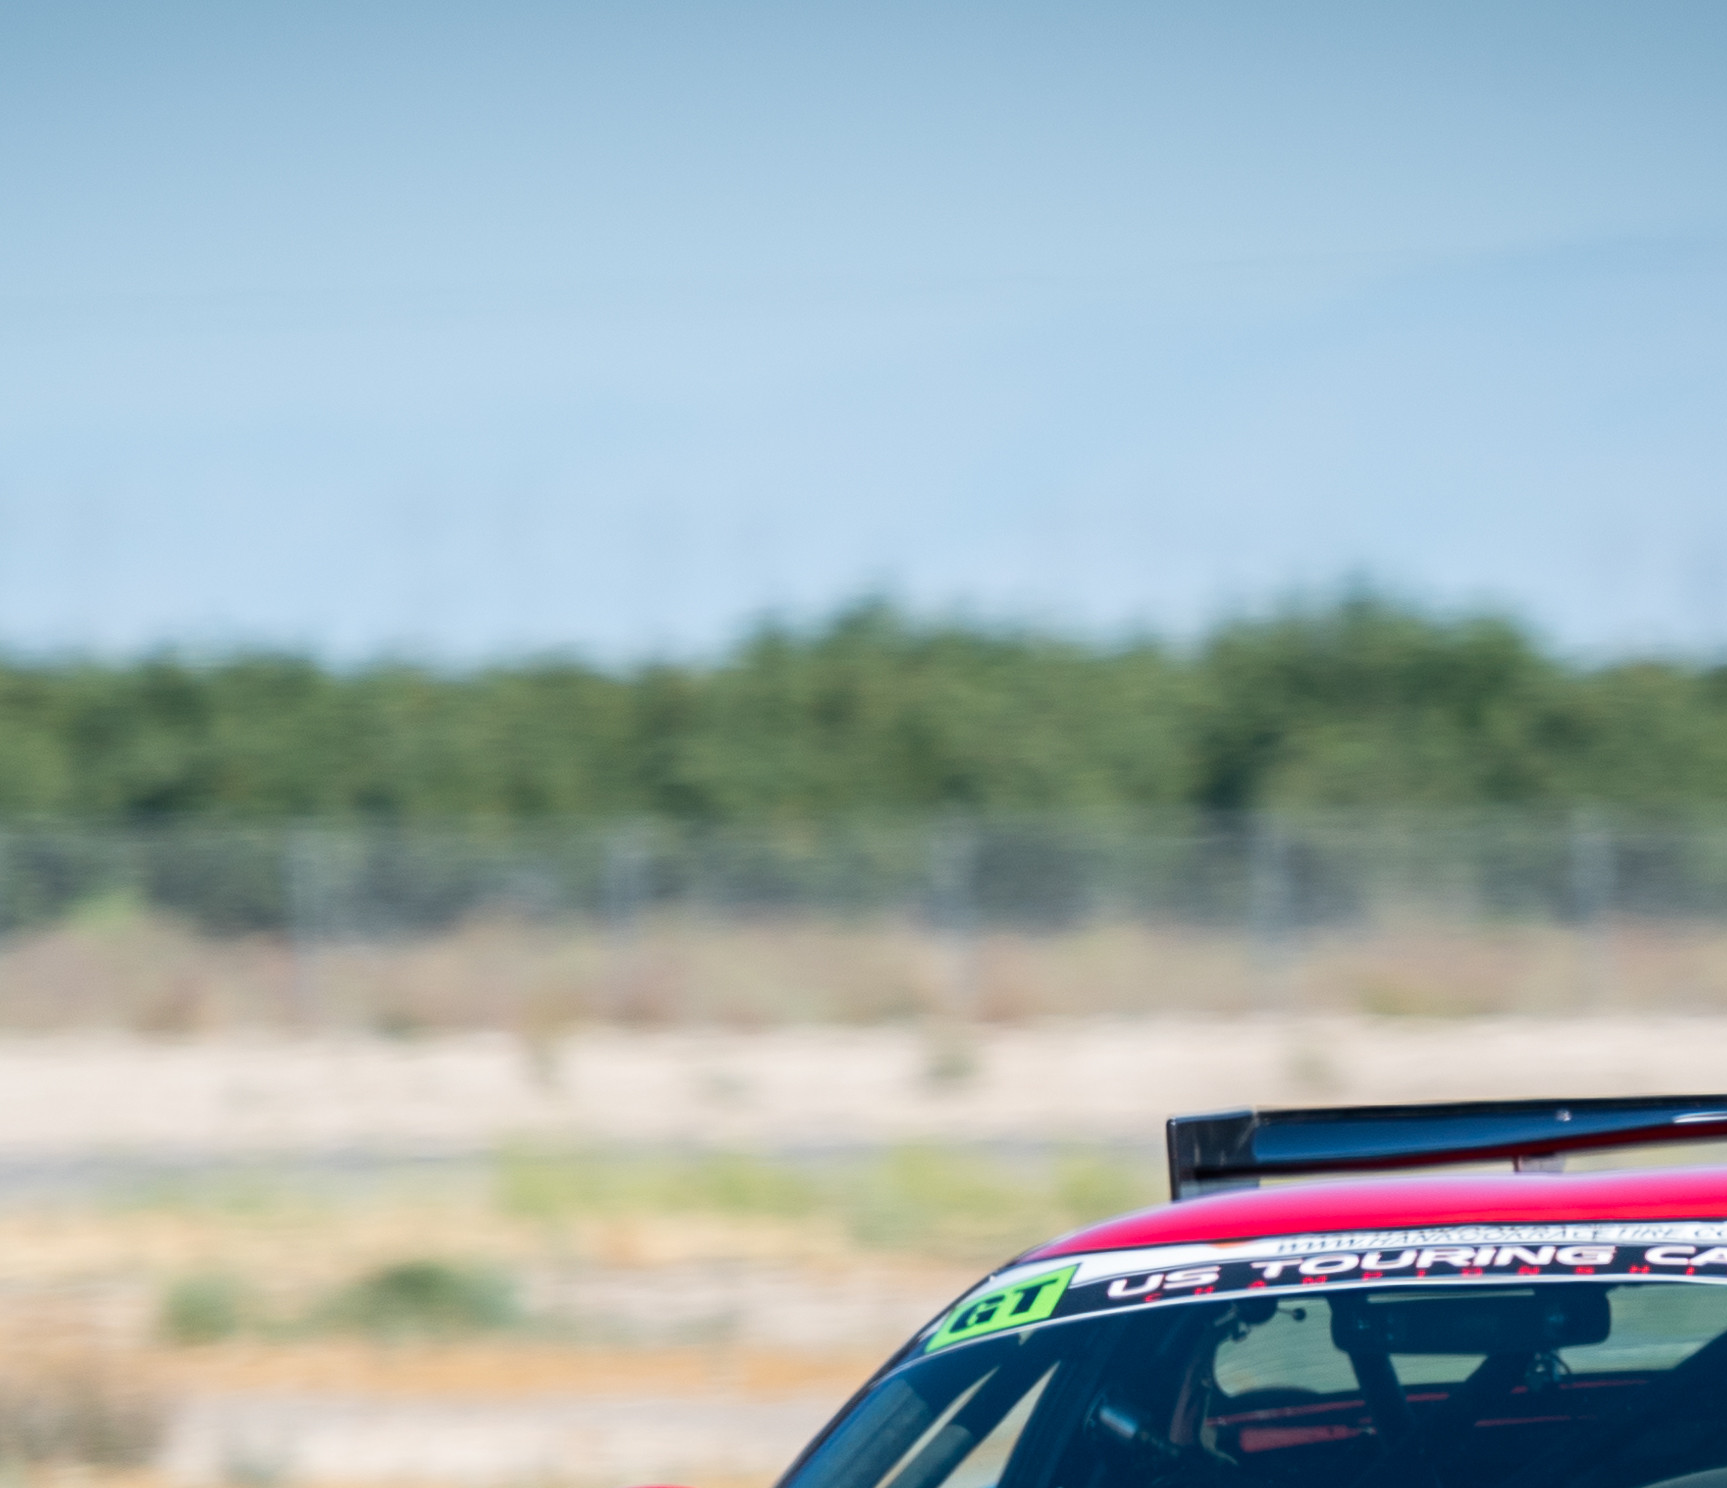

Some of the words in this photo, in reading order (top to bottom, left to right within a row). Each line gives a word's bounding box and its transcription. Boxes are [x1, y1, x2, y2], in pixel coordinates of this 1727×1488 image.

[1107, 1265, 1221, 1299] US
[1250, 1245, 1616, 1279] TOURING
[948, 1277, 1060, 1334] GT
